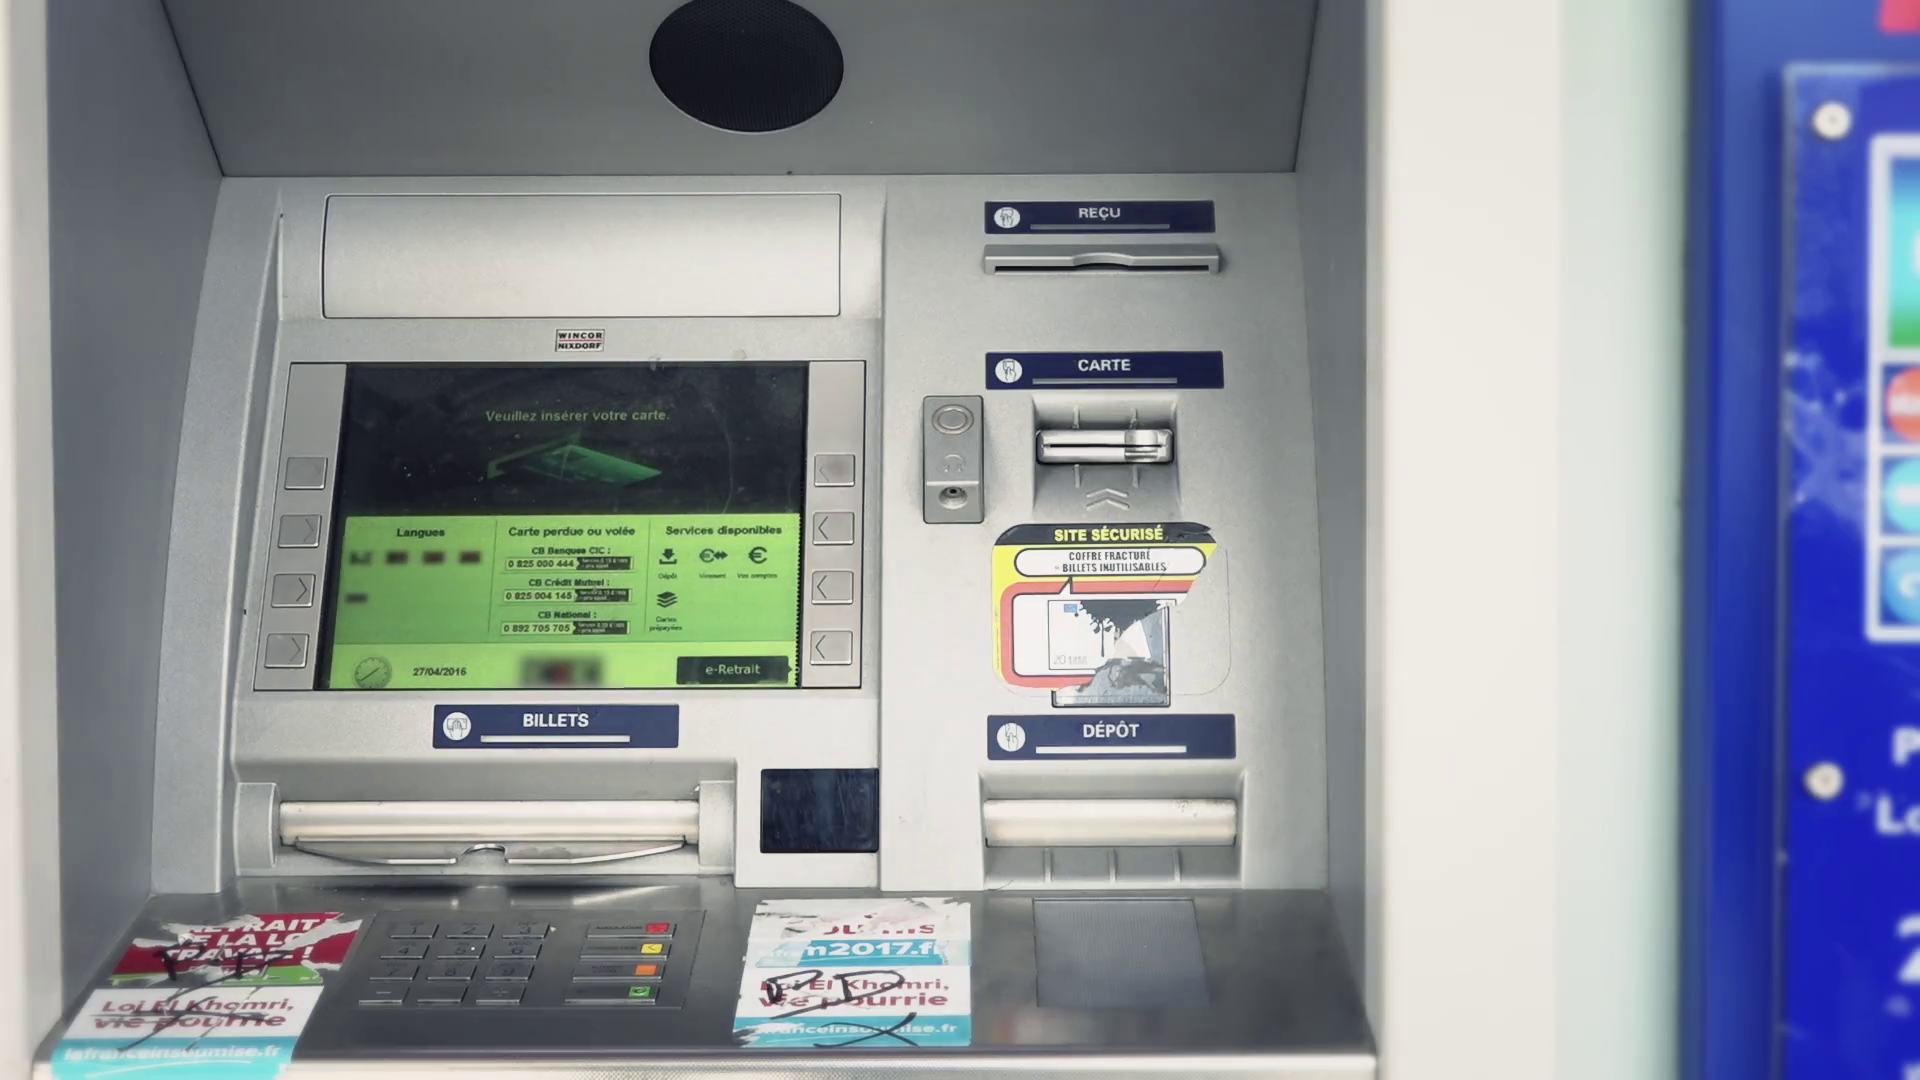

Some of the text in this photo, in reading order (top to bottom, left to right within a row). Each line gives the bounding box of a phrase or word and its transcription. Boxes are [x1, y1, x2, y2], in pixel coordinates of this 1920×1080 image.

[1078, 207, 1121, 221] REÇU
[558, 342, 602, 350] NIXDORF
[1078, 359, 1131, 372] CARTE
[486, 410, 670, 421] Veuillez insérer votre carte.
[396, 527, 445, 539] Langues
[508, 526, 635, 538] Carte perdue ou volée
[665, 525, 782, 537] Services disponibles
[1054, 524, 1164, 542] SITE SÉCURISÉ
[531, 547, 545, 555] CB
[589, 546, 605, 554] CIC
[1068, 551, 1102, 561] COFFRE
[507, 560, 514, 568] 0
[516, 560, 534, 568] 825
[1062, 562, 1167, 573] BILLETS INUTILISABLES
[528, 579, 542, 587] CB
[505, 592, 512, 600] 0
[538, 611, 551, 619] CB
[553, 611, 591, 619] National
[503, 624, 510, 632] 0
[512, 624, 530, 632] 892
[532, 624, 550, 632] 705
[552, 624, 571, 632] 705
[412, 667, 468, 677] 27/04/2016
[705, 664, 761, 675] e-Retrait
[523, 713, 589, 727] BILLETS
[1083, 721, 1140, 738] DÉPÔT
[216, 933, 259, 946] LA
[808, 979, 833, 991] El
[847, 978, 950, 992] Khomri,
[101, 1000, 146, 1013] Loi
[185, 998, 295, 1013] Khomri,
[94, 1015, 140, 1029] vie
